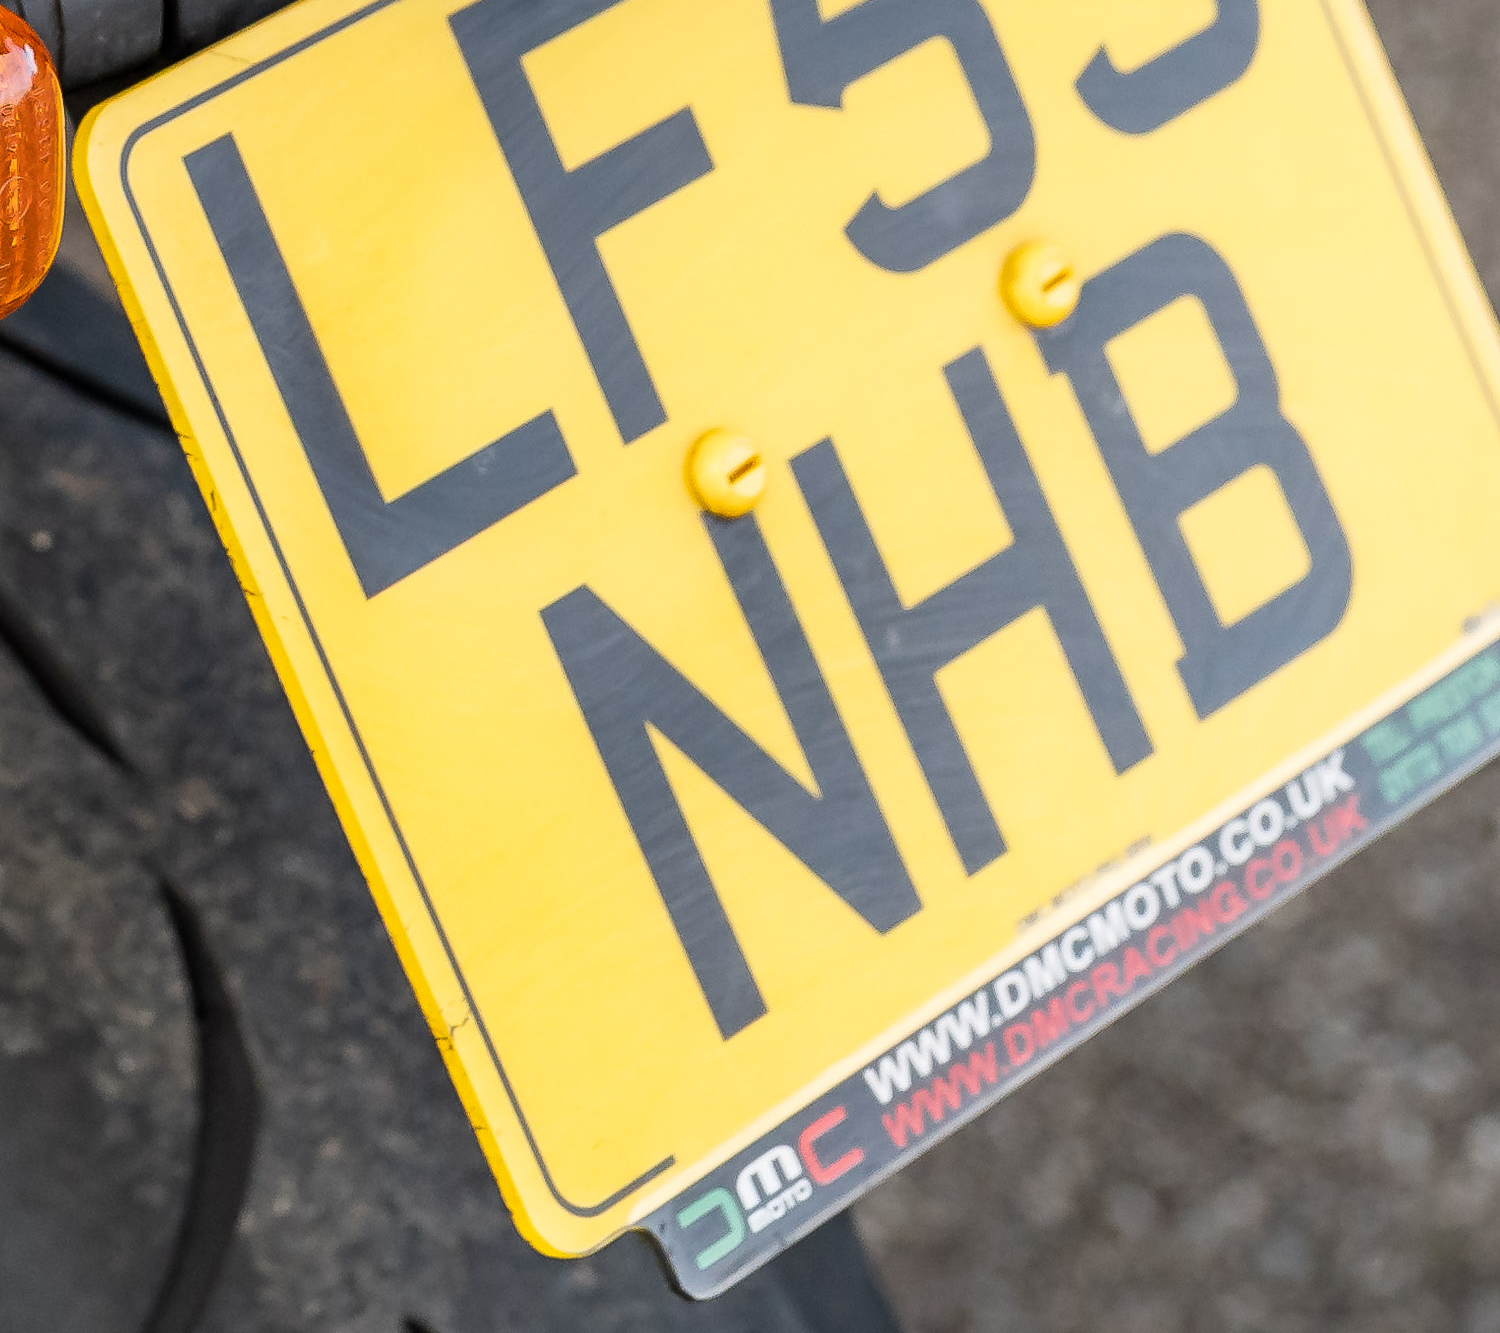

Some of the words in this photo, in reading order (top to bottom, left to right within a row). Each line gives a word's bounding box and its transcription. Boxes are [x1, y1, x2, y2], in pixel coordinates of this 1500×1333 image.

[538, 229, 1356, 1042] NHB
[862, 748, 1357, 1106] WWW.DMCMOTO.CO.UK
[881, 794, 1369, 1148] WWW.DMCRACING.CO.UK
